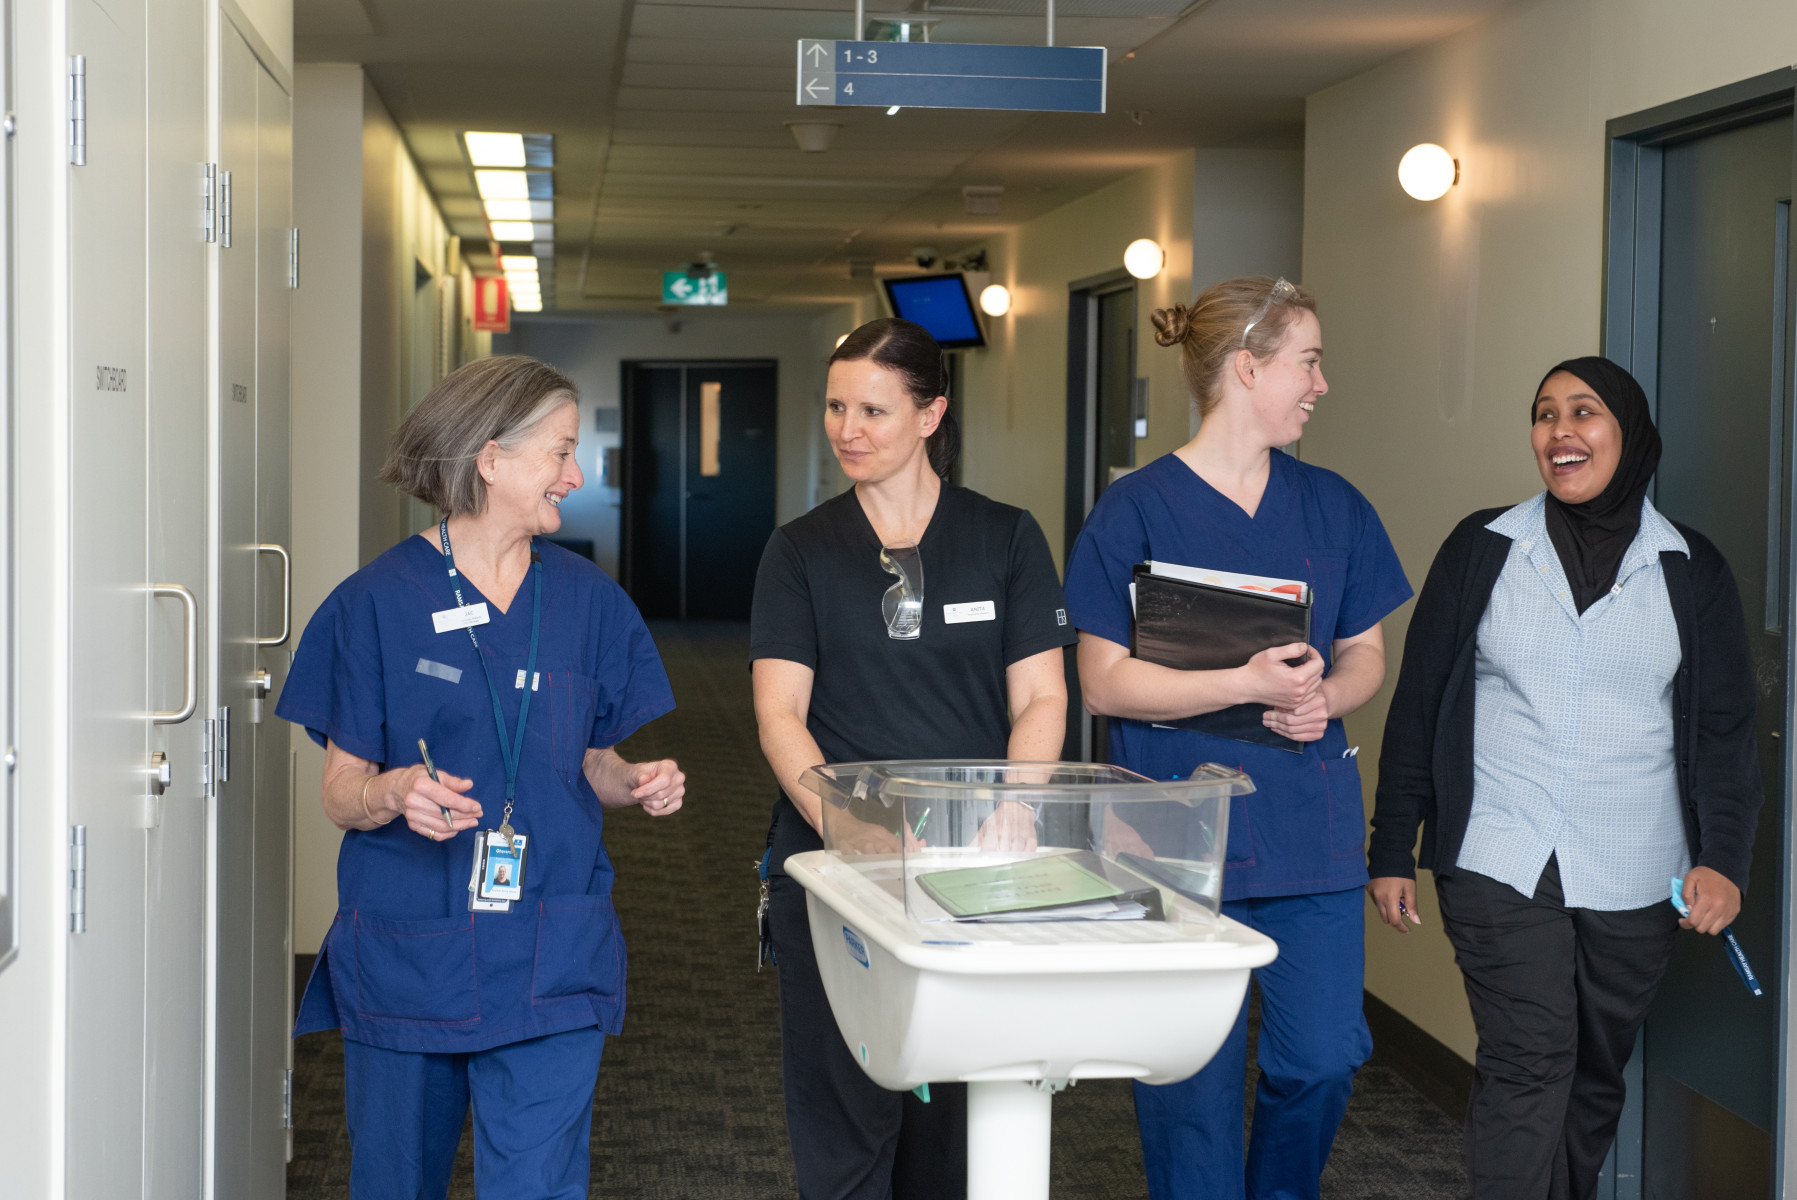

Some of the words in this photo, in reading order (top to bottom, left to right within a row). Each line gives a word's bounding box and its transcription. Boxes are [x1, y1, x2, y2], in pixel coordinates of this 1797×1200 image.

[843, 82, 854, 96] 4
[96, 365, 127, 392] SWITCHBOARD
[443, 541, 451, 556] CARE
[1728, 934, 1737, 946] CARE
[1735, 946, 1745, 963] HEALTH
[1743, 962, 1754, 980] RAMSAY
